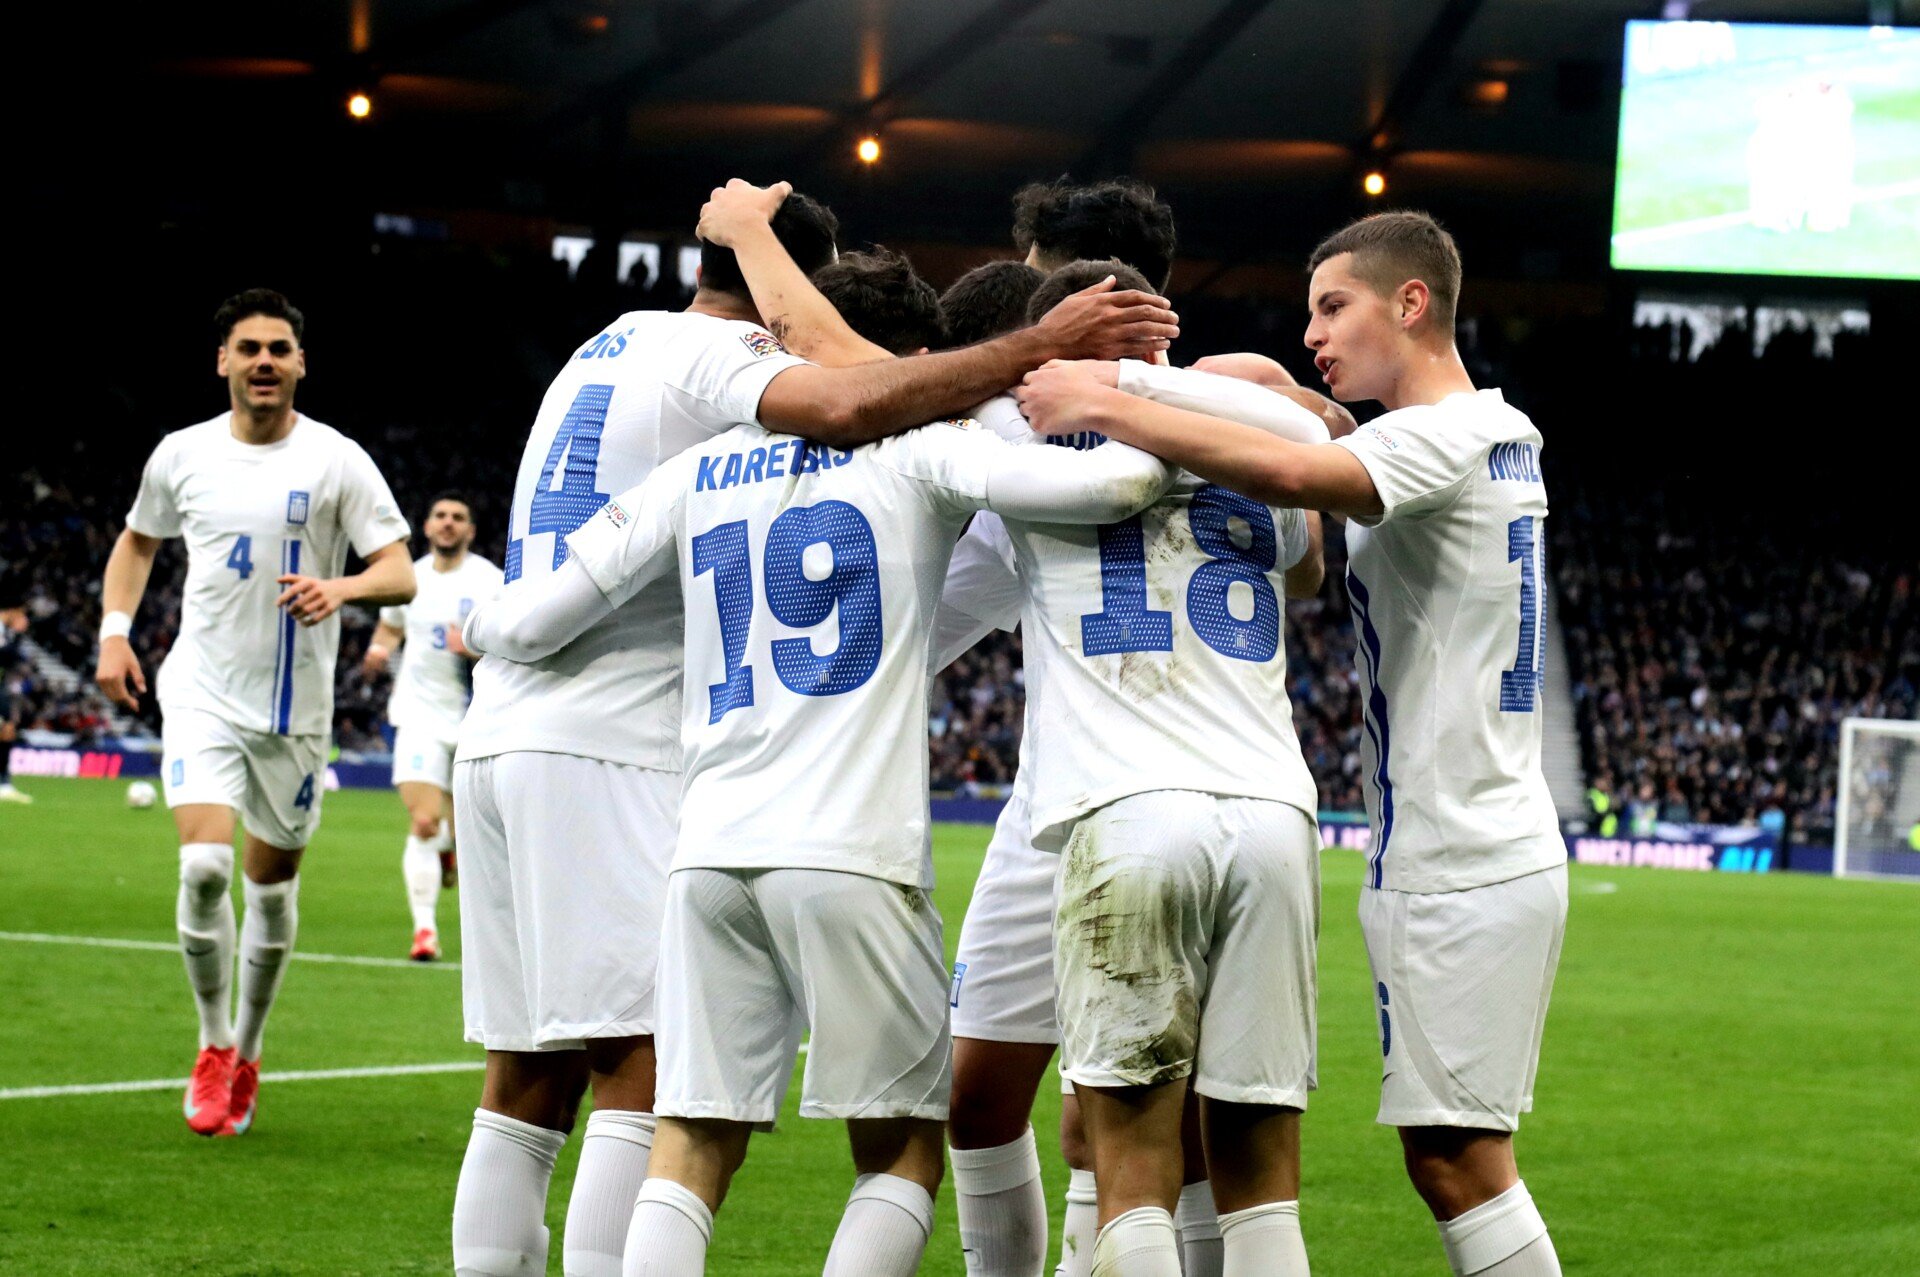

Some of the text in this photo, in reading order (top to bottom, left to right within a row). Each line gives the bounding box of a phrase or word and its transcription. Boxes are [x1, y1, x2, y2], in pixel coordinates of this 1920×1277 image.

[1488, 442, 1541, 483] MOUZ
[226, 535, 254, 579] 4
[1081, 483, 1280, 662] 18
[692, 500, 883, 725] 19
[1500, 516, 1547, 711] 1
[431, 624, 447, 650] 3
[294, 772, 316, 812] 4
